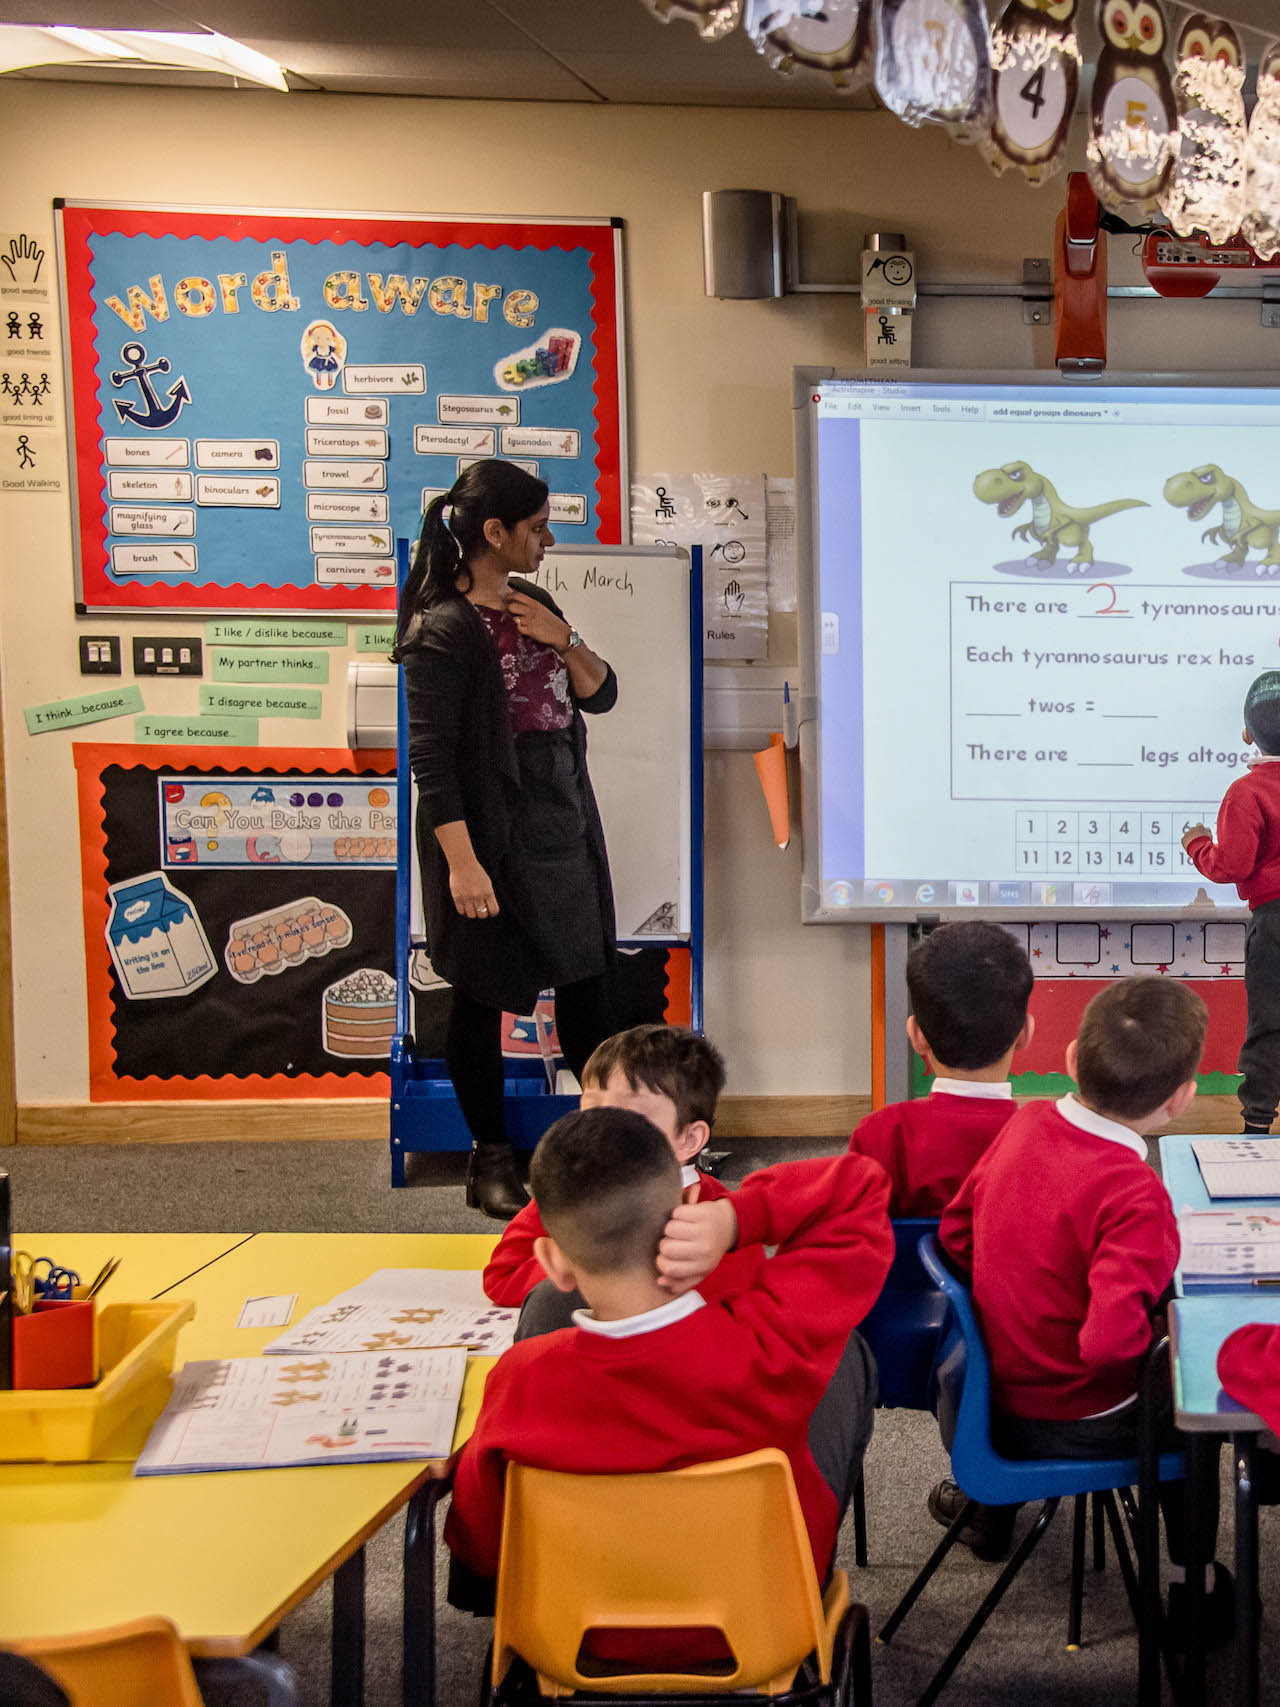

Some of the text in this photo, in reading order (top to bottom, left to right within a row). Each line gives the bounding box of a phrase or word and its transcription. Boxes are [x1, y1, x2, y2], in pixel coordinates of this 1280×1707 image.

[1020, 66, 1045, 119] 4
[1, 287, 48, 297] good waiting
[323, 270, 540, 328] aware
[868, 297, 912, 306] good thinking
[7, 348, 51, 357] good friends
[869, 358, 887, 367] good
[354, 375, 394, 384] herbivore
[327, 406, 349, 416] fossil
[442, 404, 494, 414] Stegosaurus
[824, 402, 979, 415] File Edit View Insert Tools Help
[993, 408, 1008, 416] add
[1009, 408, 1032, 418] equal
[1033, 409, 1061, 418] groups
[1062, 409, 1102, 417] dinosaurs
[2, 413, 54, 423] good lining up
[313, 438, 360, 447] Triceratops
[421, 435, 469, 446] Pterodactyl
[508, 437, 552, 447] Iguanodon
[125, 449, 150, 457] bones
[211, 450, 243, 458] camera
[322, 470, 349, 479] trowel
[2, 478, 60, 489] Good Walking
[122, 480, 158, 489] skeleton
[204, 485, 250, 495] binoculars
[313, 503, 360, 512] microscope
[117, 512, 168, 522] magnifying
[131, 522, 154, 531] glass
[133, 554, 158, 563] brush
[326, 565, 366, 575] carnivore
[583, 566, 634, 597] March
[965, 595, 1028, 616] There
[1034, 600, 1069, 615] are
[1086, 583, 1130, 614] 2
[215, 627, 220, 637] I
[223, 628, 243, 637] like
[255, 628, 289, 638] dislike
[707, 630, 736, 640] Rules
[364, 635, 392, 645] I like
[965, 646, 1014, 664] Each
[1022, 649, 1169, 669] tyrannosaurus
[1177, 652, 1211, 666] rex
[1218, 647, 1256, 667] has
[219, 657, 235, 669] My
[238, 658, 278, 670] partner
[208, 696, 214, 706] I
[218, 697, 262, 709] disagree
[1028, 697, 1076, 714] twos
[36, 714, 43, 724] I
[145, 726, 151, 736] I
[154, 728, 184, 738] agree
[966, 744, 1028, 763] There
[1034, 748, 1069, 762] are
[1140, 745, 1180, 765] legs
[175, 810, 218, 830] Can
[225, 811, 264, 830] You
[271, 811, 320, 830] Bake
[328, 811, 361, 830] the
[1027, 819, 1034, 834] 1
[1056, 819, 1068, 834] 2
[1088, 820, 1099, 835] 3
[1119, 820, 1130, 834] 4
[1151, 820, 1161, 835] 5
[1023, 850, 1039, 865] 11
[1053, 850, 1072, 865] 12
[1085, 851, 1104, 866] 13
[1116, 851, 1135, 865] 14
[1147, 852, 1166, 866] 15
[248, 941, 265, 952] read
[284, 924, 310, 938] makes
